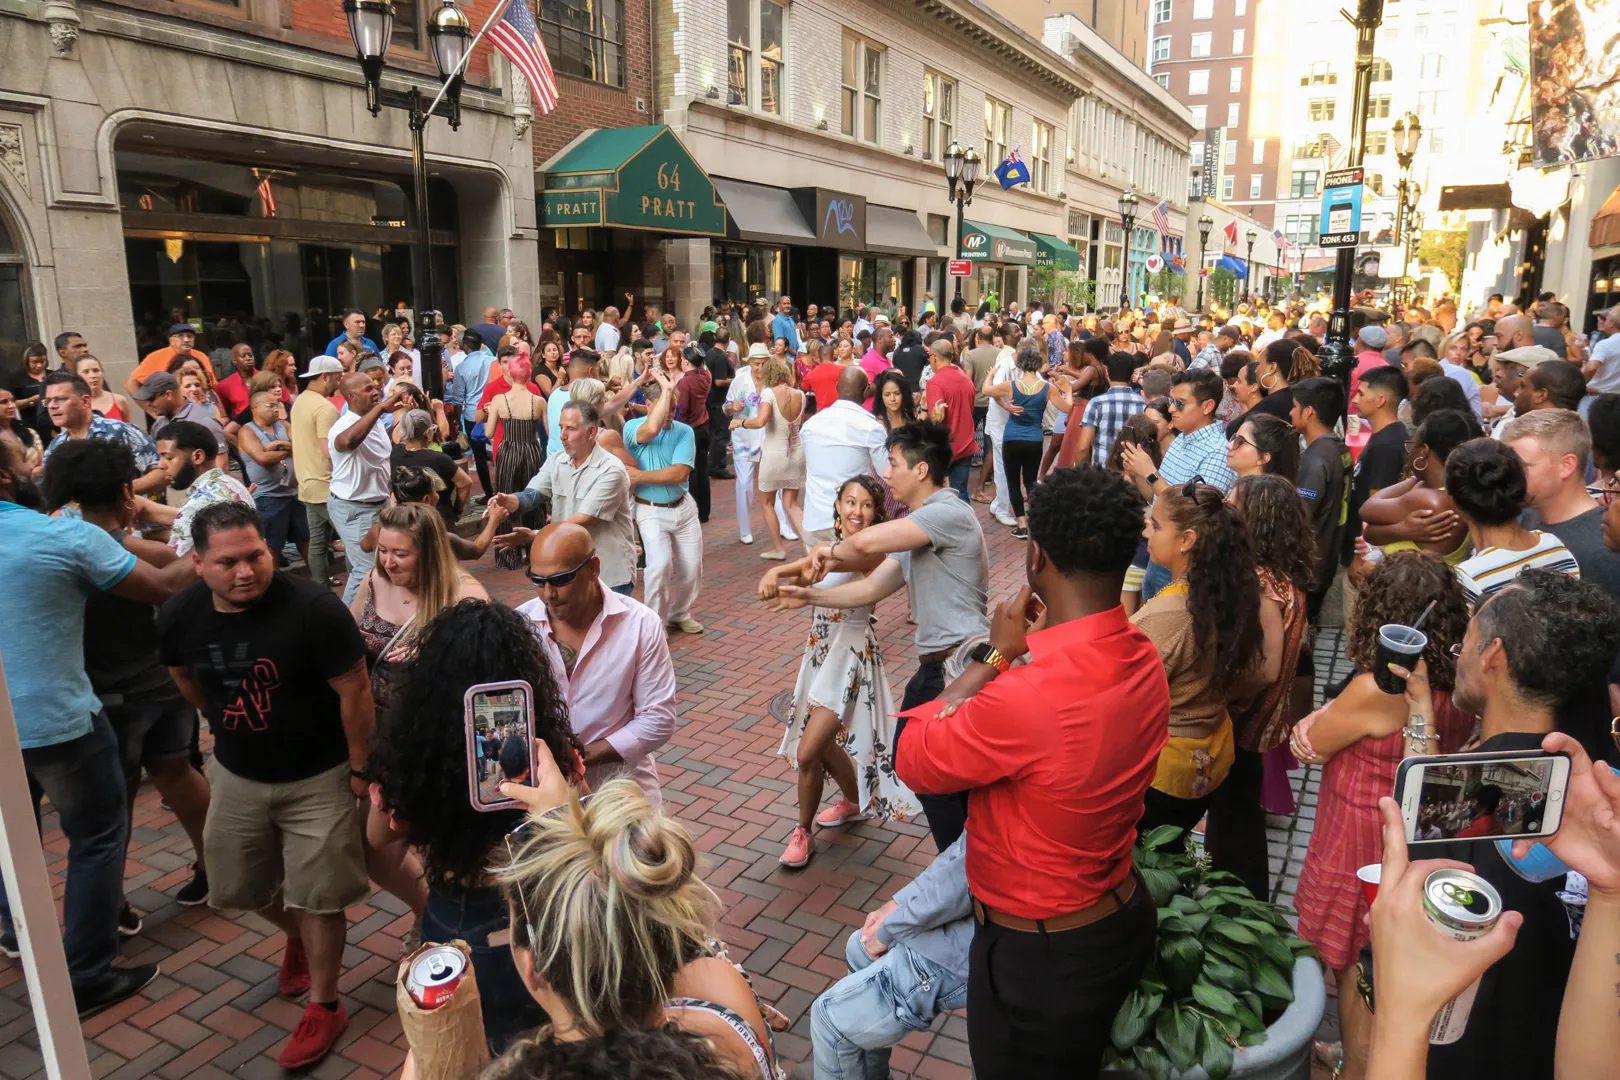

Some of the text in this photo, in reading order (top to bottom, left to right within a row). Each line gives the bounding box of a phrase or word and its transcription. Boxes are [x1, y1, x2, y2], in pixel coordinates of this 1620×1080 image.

[657, 162, 680, 191] 64
[1325, 176, 1353, 186] PHONE
[556, 202, 597, 215] PRATT
[642, 196, 695, 219] PRATT
[1321, 234, 1355, 244] ZONE 453
